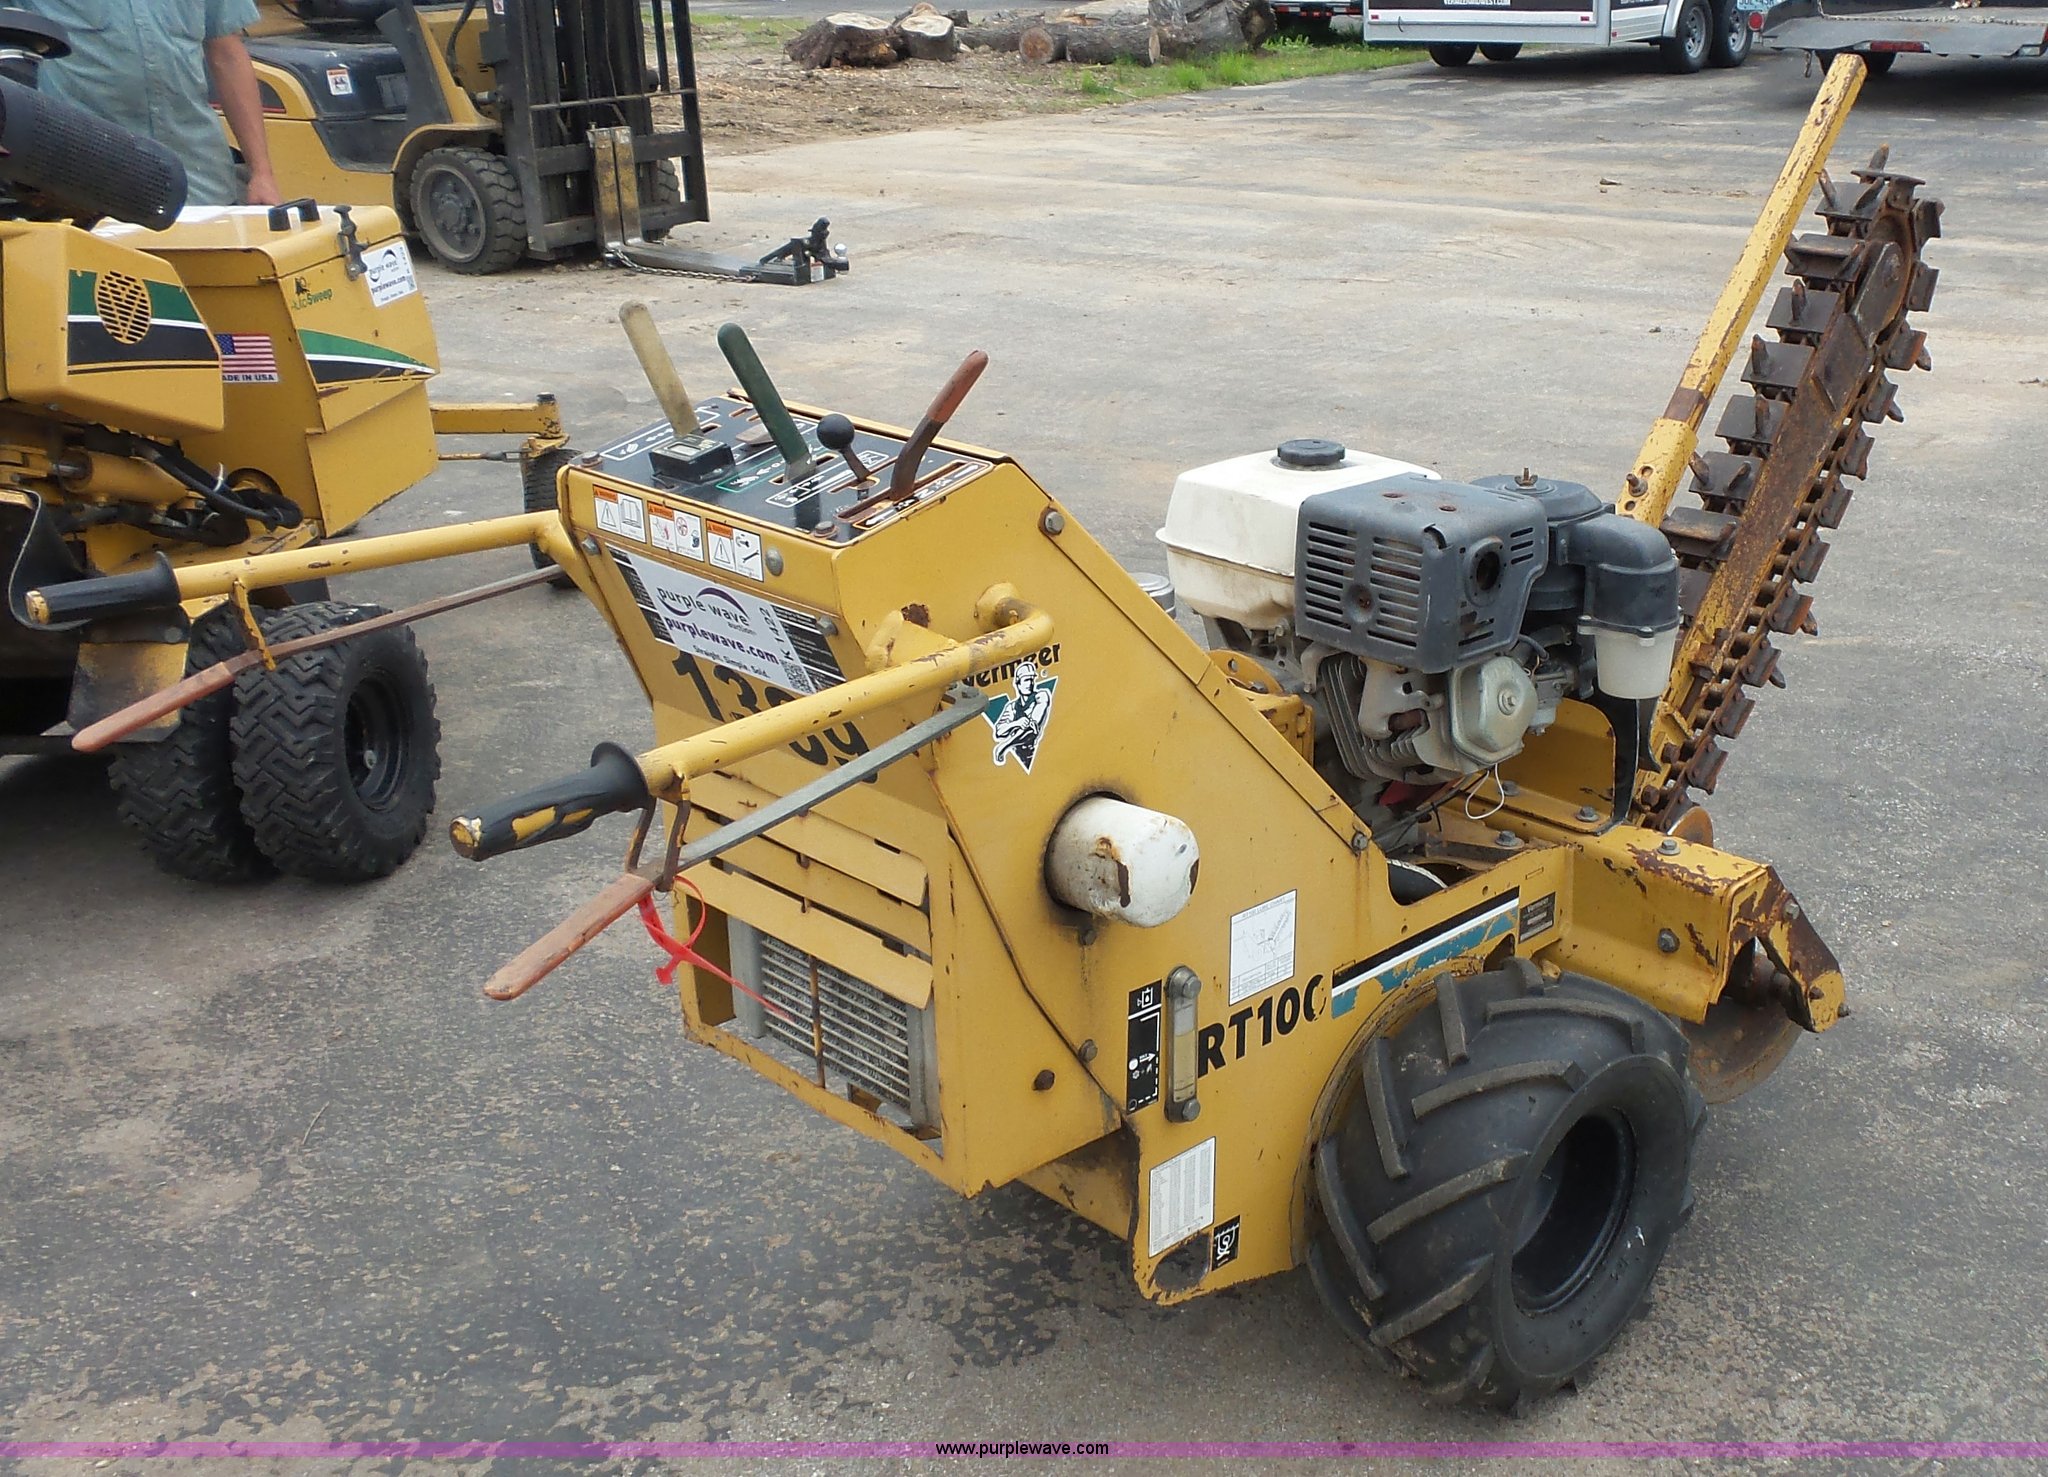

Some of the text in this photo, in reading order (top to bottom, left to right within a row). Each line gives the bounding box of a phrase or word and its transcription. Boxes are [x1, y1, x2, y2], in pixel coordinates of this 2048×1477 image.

[656, 587, 707, 612] purple
[708, 603, 750, 627] wave
[663, 616, 780, 666] purplewave.com
